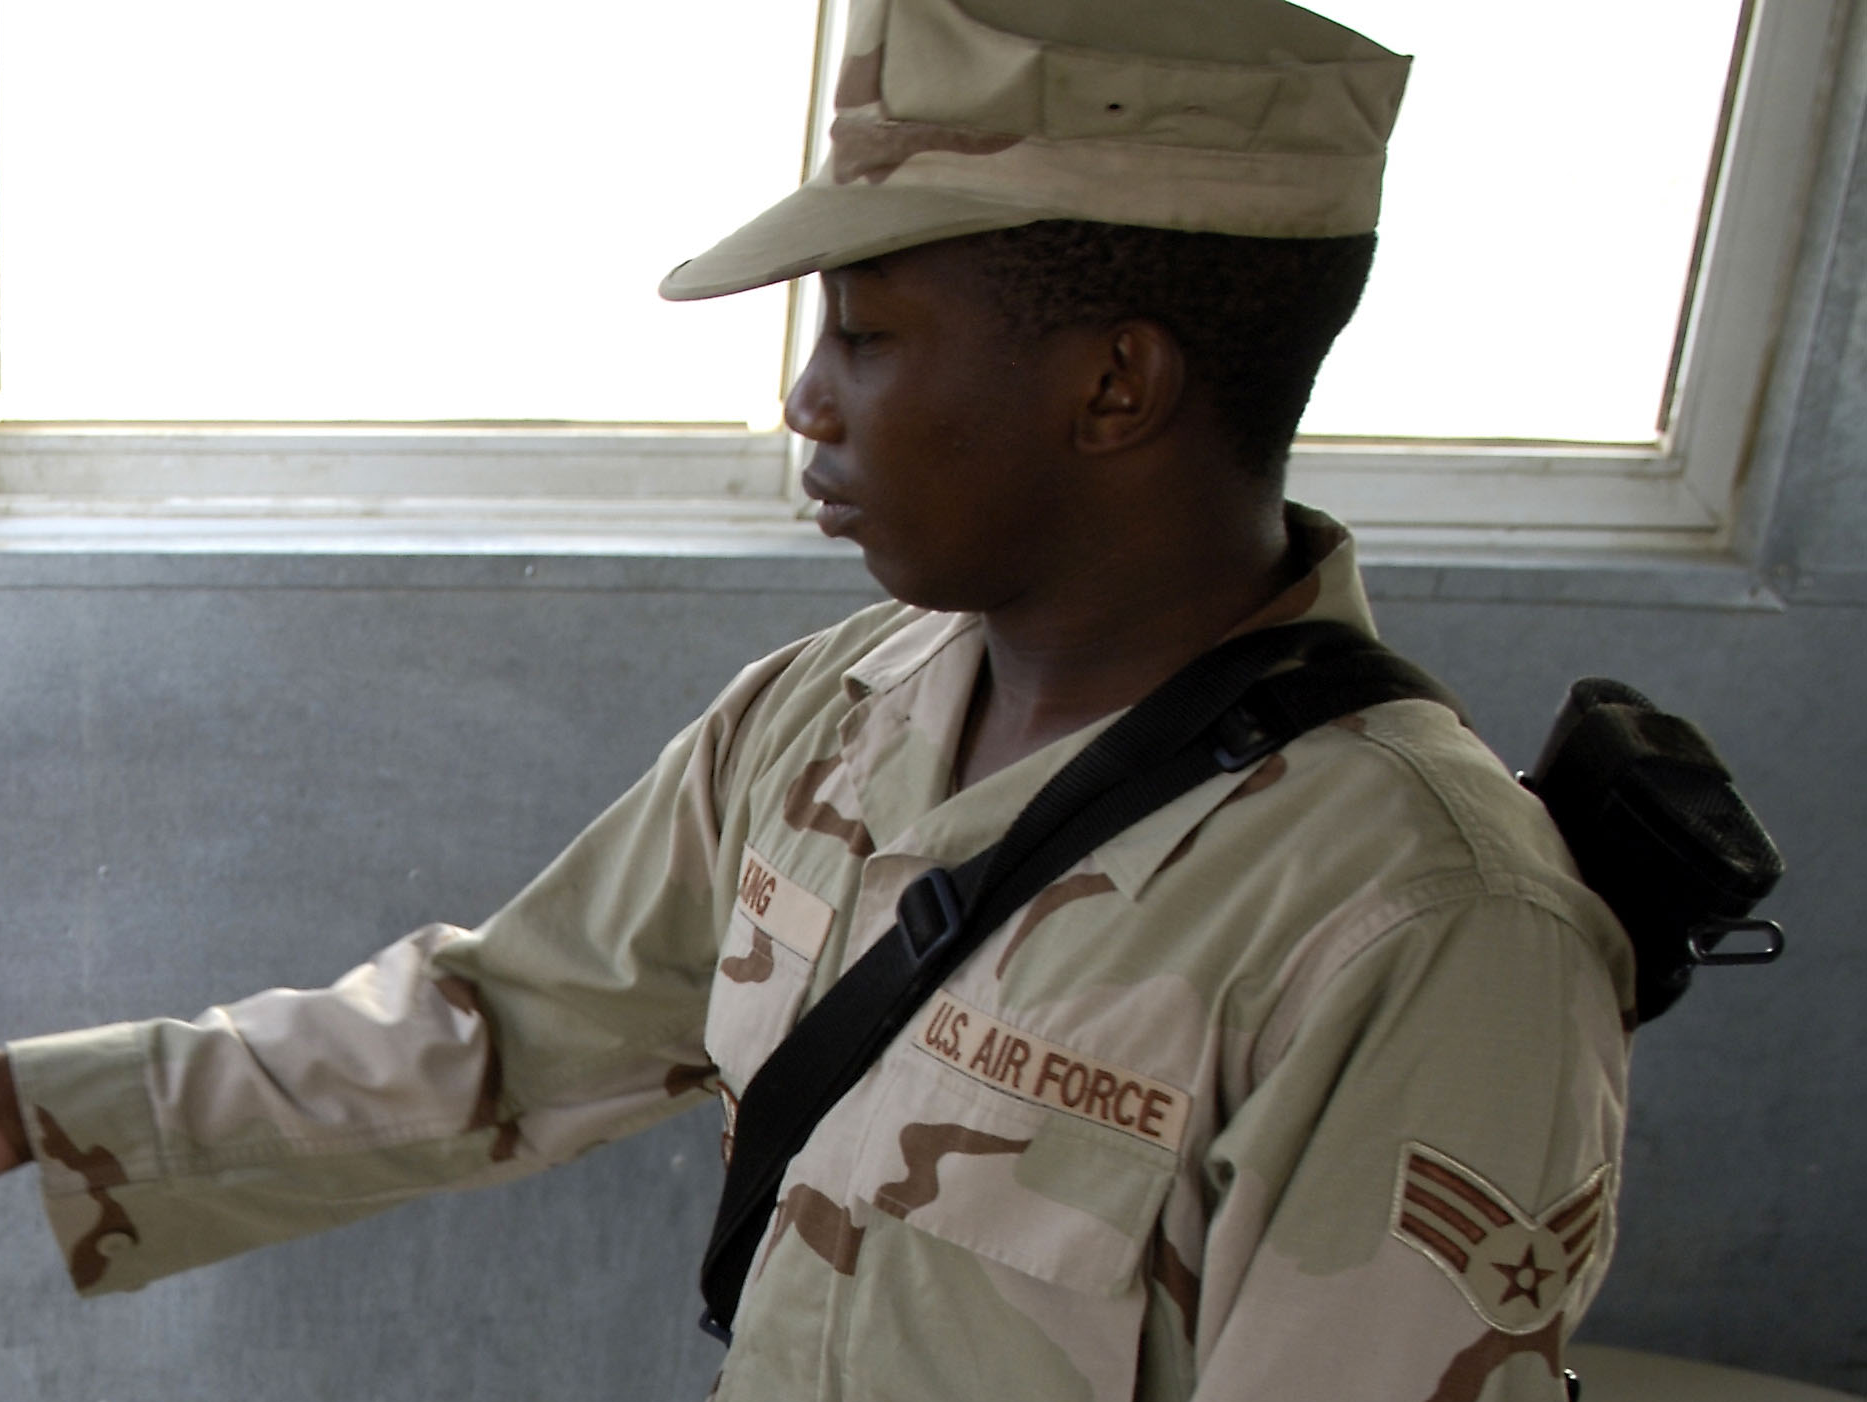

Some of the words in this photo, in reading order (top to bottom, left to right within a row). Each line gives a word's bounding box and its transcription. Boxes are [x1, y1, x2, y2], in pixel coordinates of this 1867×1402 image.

[925, 1001, 969, 1062] U.S.
[969, 1027, 1030, 1089] AIR
[1033, 1052, 1173, 1138] FORCE
